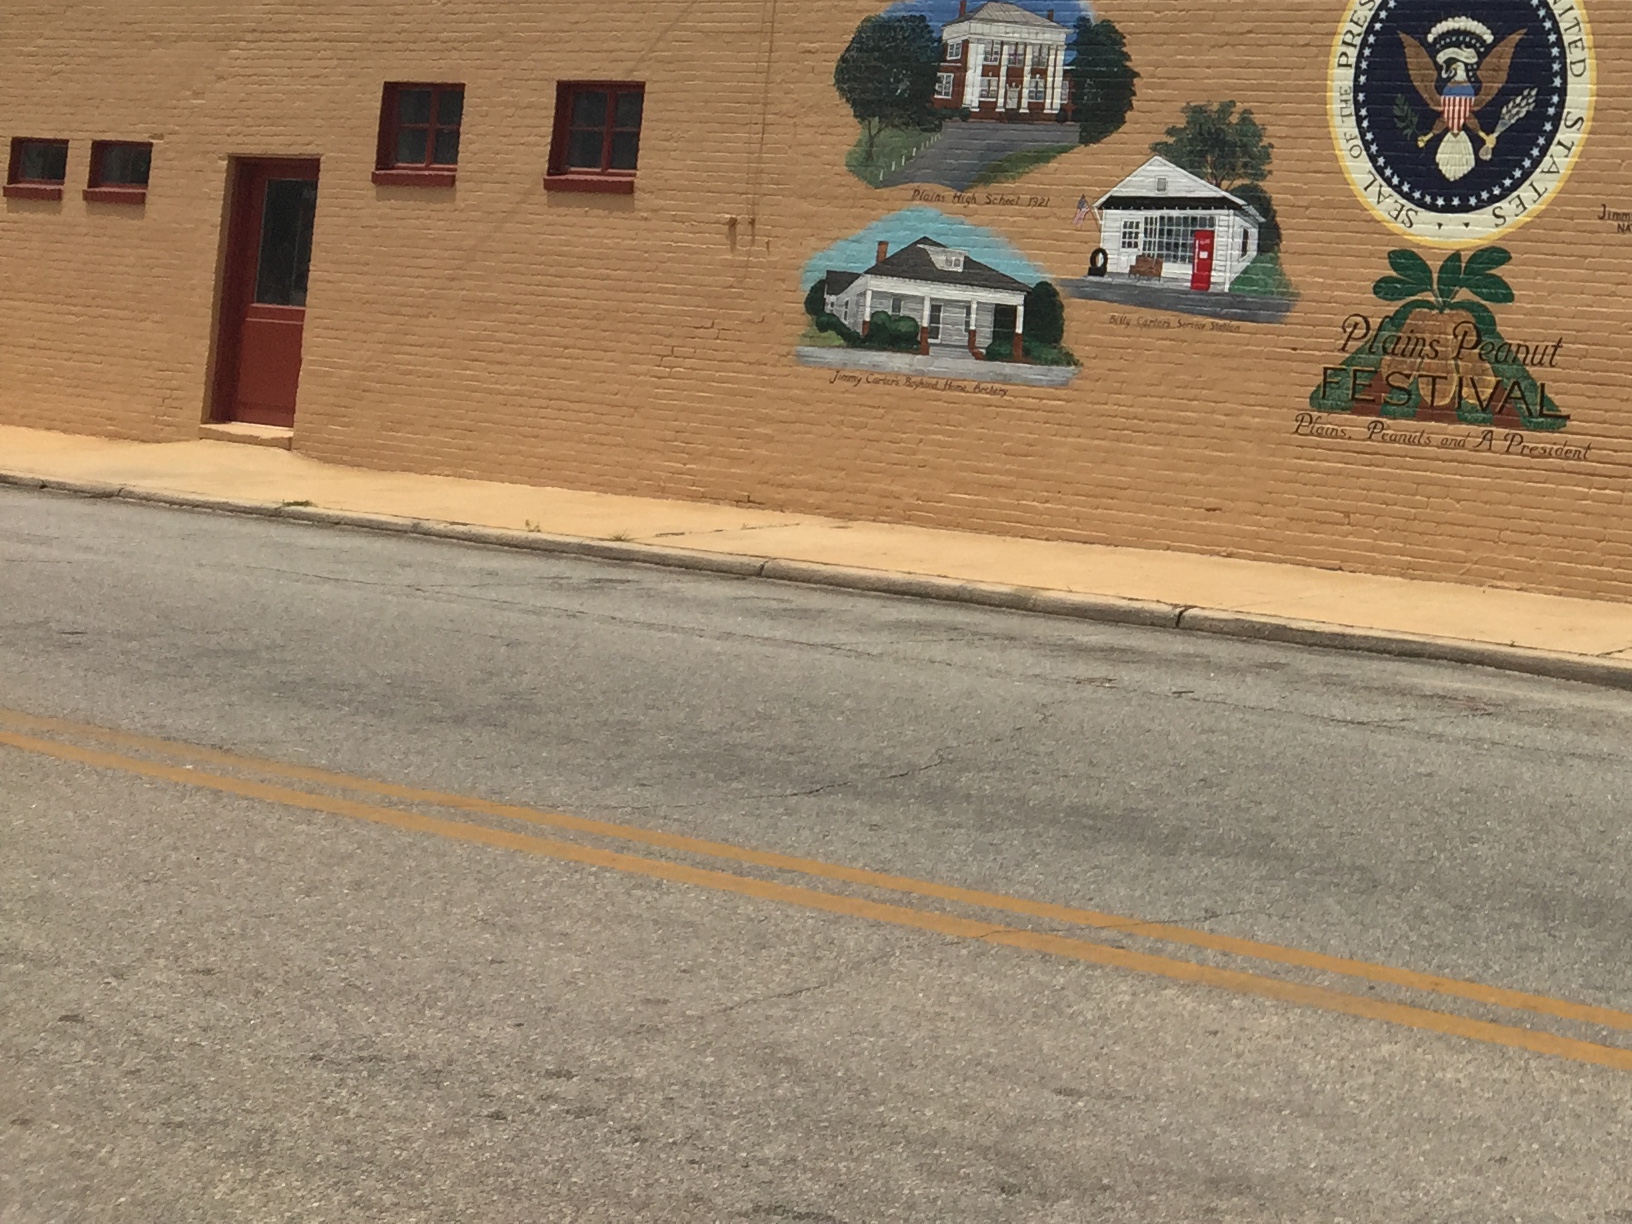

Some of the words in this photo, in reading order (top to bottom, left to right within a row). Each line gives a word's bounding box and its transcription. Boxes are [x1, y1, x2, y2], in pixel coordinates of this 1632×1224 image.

[1339, 85, 1353, 124] THE
[1343, 131, 1363, 159] OF
[1492, 110, 1585, 228] STATES
[910, 188, 946, 204] Plains
[952, 192, 977, 209] High
[984, 192, 1021, 207] School
[1362, 170, 1419, 229] SEAL
[1337, 313, 1442, 361] Plains
[1452, 320, 1564, 369] Peanut
[828, 370, 863, 388] Jimmy
[1320, 365, 1572, 420] FESTIVAL
[1366, 420, 1432, 446] Peanuts
[1440, 431, 1471, 449] and
[1472, 429, 1495, 452] A
[1503, 432, 1593, 461] President
